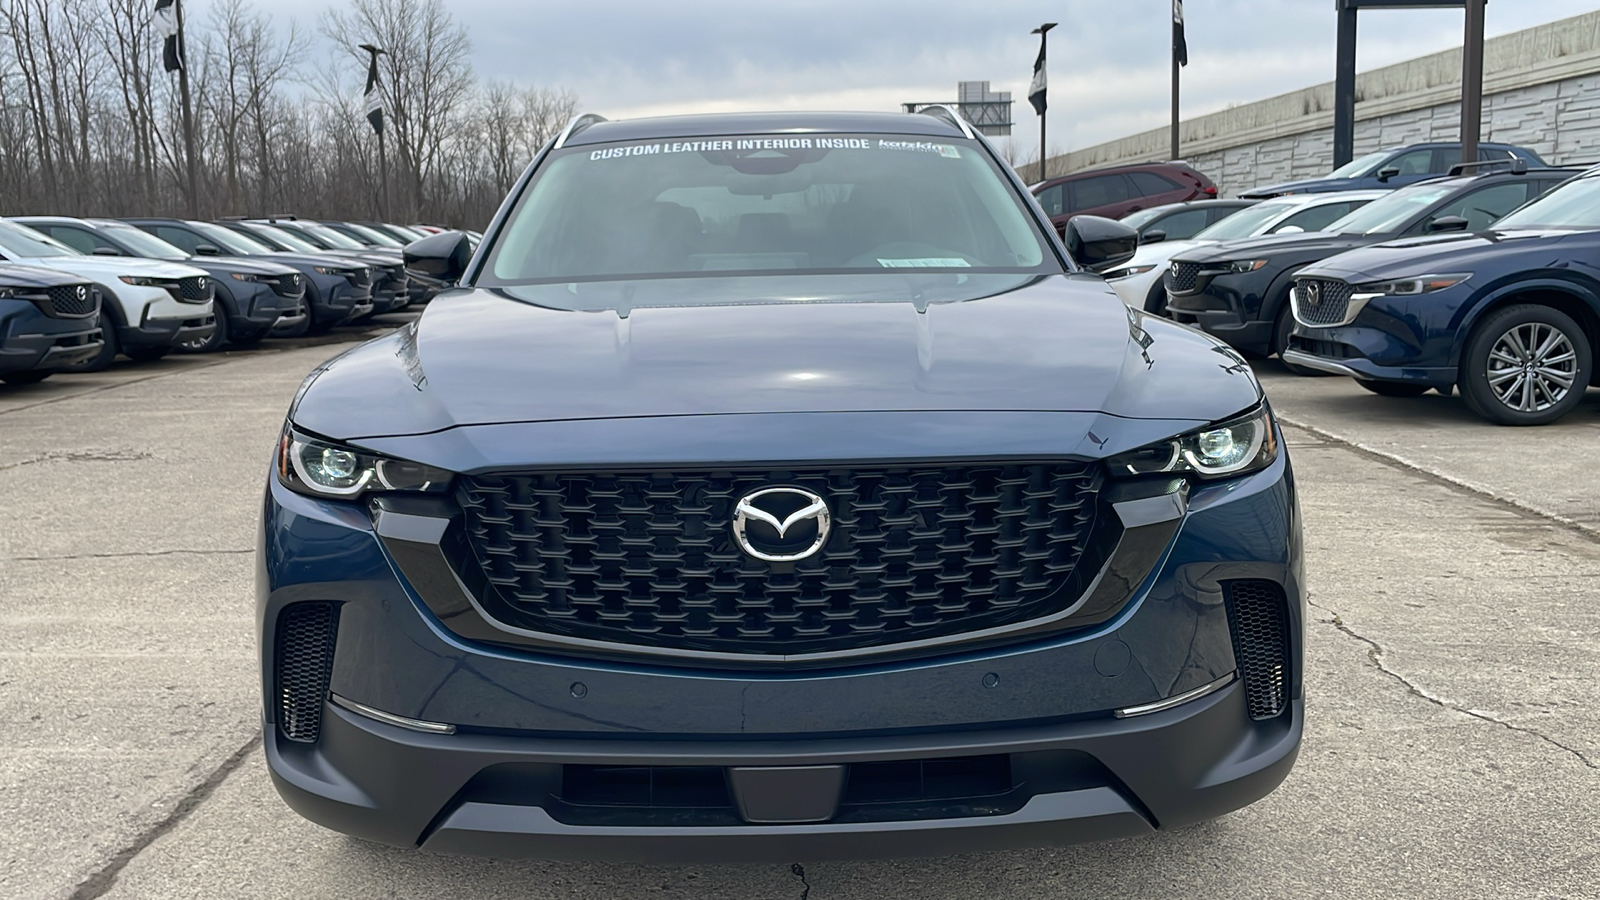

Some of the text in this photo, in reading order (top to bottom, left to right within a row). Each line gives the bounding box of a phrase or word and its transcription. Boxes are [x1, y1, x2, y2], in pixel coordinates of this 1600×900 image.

[590, 144, 661, 161] CUSTOM
[664, 140, 733, 154] LEATHER
[736, 138, 812, 151] INTERIOR
[815, 138, 870, 150] INSIDE
